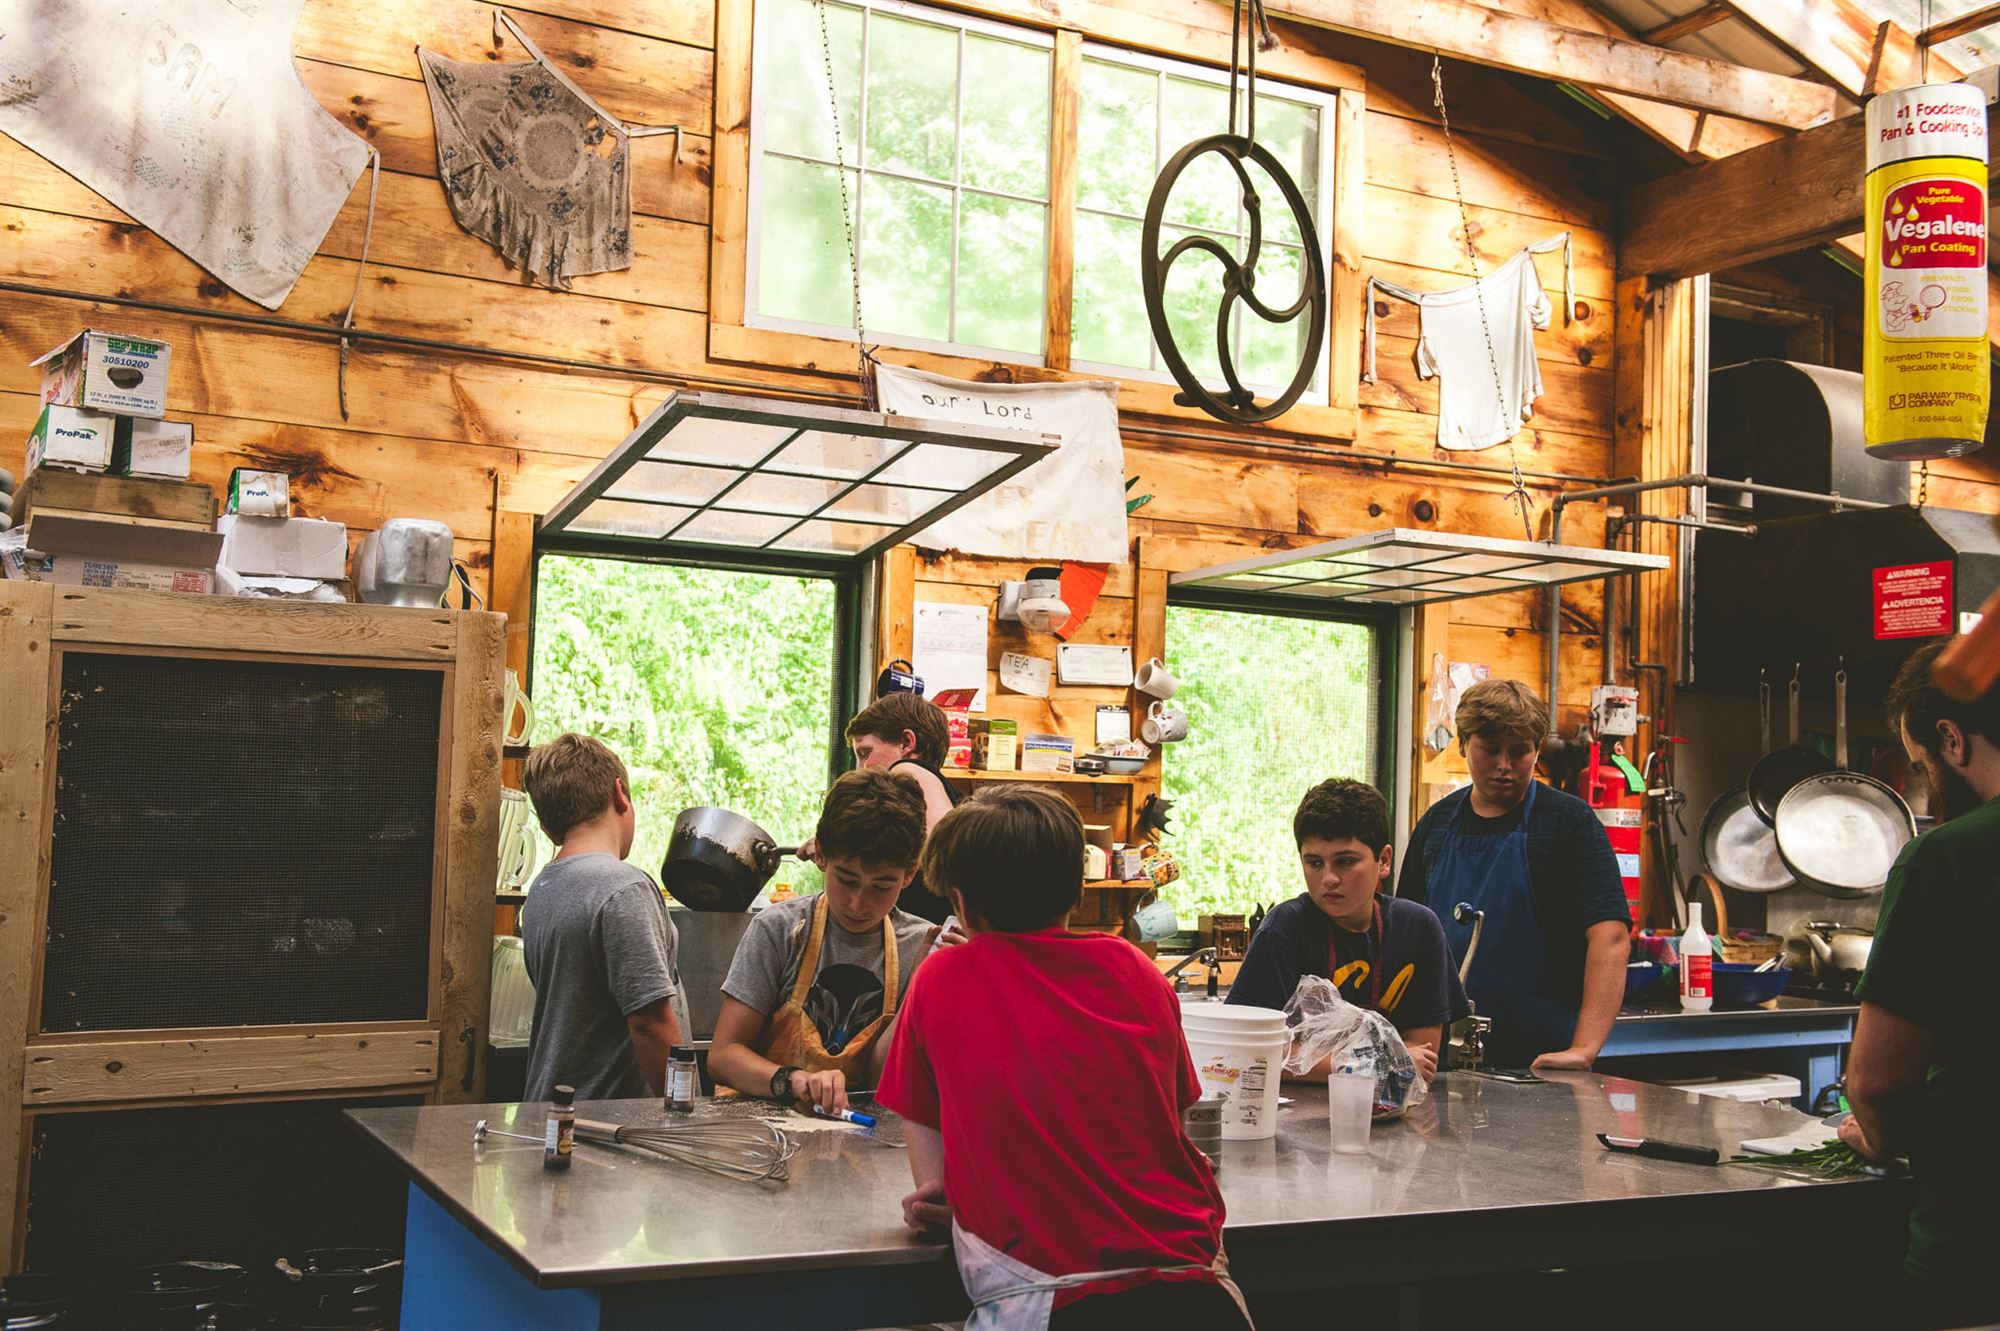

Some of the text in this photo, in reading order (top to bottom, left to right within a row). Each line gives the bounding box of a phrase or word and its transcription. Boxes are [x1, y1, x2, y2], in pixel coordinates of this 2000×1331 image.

[1896, 105, 1911, 119] #1
[1881, 127, 1902, 142] Pan
[1905, 122, 1915, 136] &
[1920, 119, 1969, 138] Cooking
[1928, 187, 1952, 195] Pure
[1916, 195, 1965, 205] Vegetable
[1885, 214, 1985, 242] Vegalene
[1902, 242, 1976, 256] Pan Coating
[102, 355, 149, 369] 30510200
[1884, 352, 1922, 363] Patented
[1925, 350, 1951, 360] Three
[1953, 351, 1966, 360] Oil
[1896, 363, 1938, 373] "Because
[1908, 391, 1952, 401] PAR-WAY
[983, 400, 1033, 420] Lord
[1908, 399, 1955, 409] COMPANY
[55, 428, 92, 440] ProPak
[1892, 567, 1930, 578] WARNING
[1889, 596, 1945, 609] ADVERTENCIA
[1007, 654, 1030, 669] TEA
